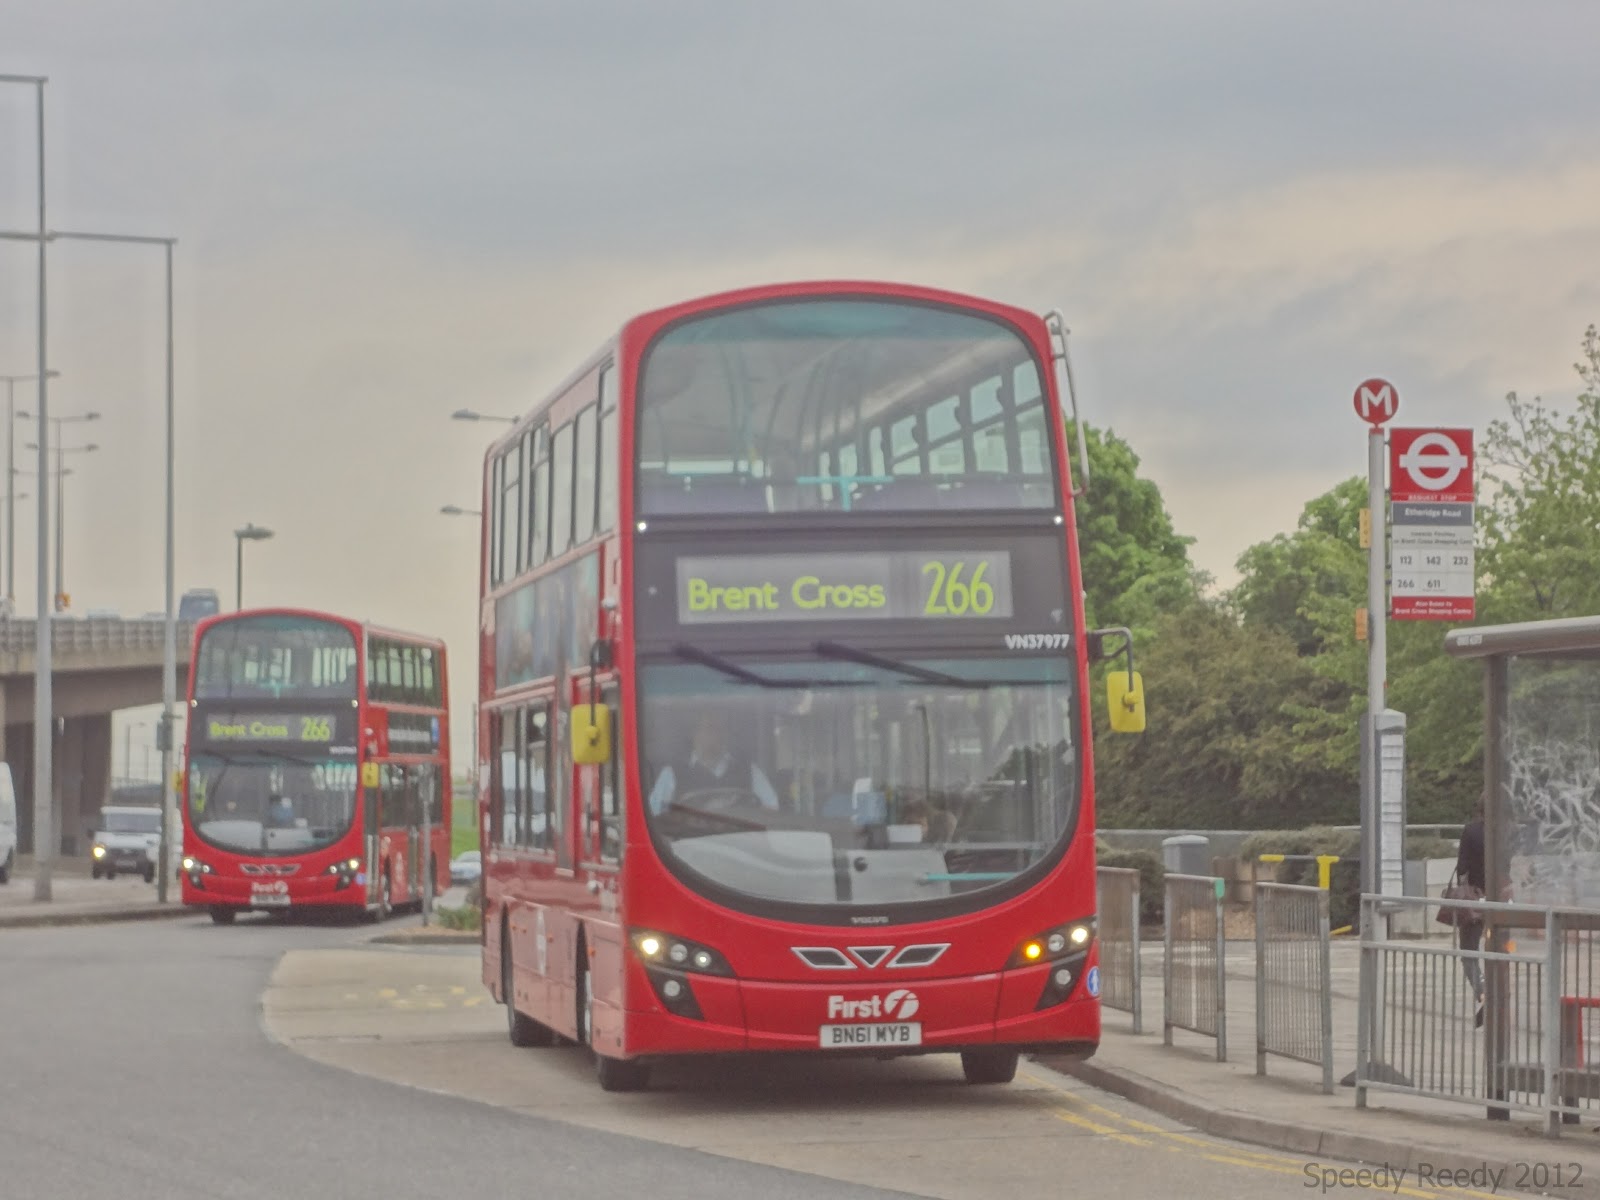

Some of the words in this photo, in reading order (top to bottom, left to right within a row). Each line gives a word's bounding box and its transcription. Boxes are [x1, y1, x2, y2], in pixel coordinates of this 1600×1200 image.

[1361, 385, 1392, 417] M
[1442, 509, 1461, 517] Road
[1453, 556, 1468, 565] 232
[688, 578, 778, 611] Brent
[792, 576, 886, 608] Cross
[922, 561, 994, 616] 266
[1398, 579, 1415, 588] 266
[1005, 634, 1069, 649] VN37977
[210, 721, 246, 737] Brent
[251, 721, 288, 737] Cross
[302, 717, 331, 742] 266
[828, 995, 881, 1018] First
[832, 1027, 871, 1044] BN61
[876, 1026, 910, 1042] MYB
